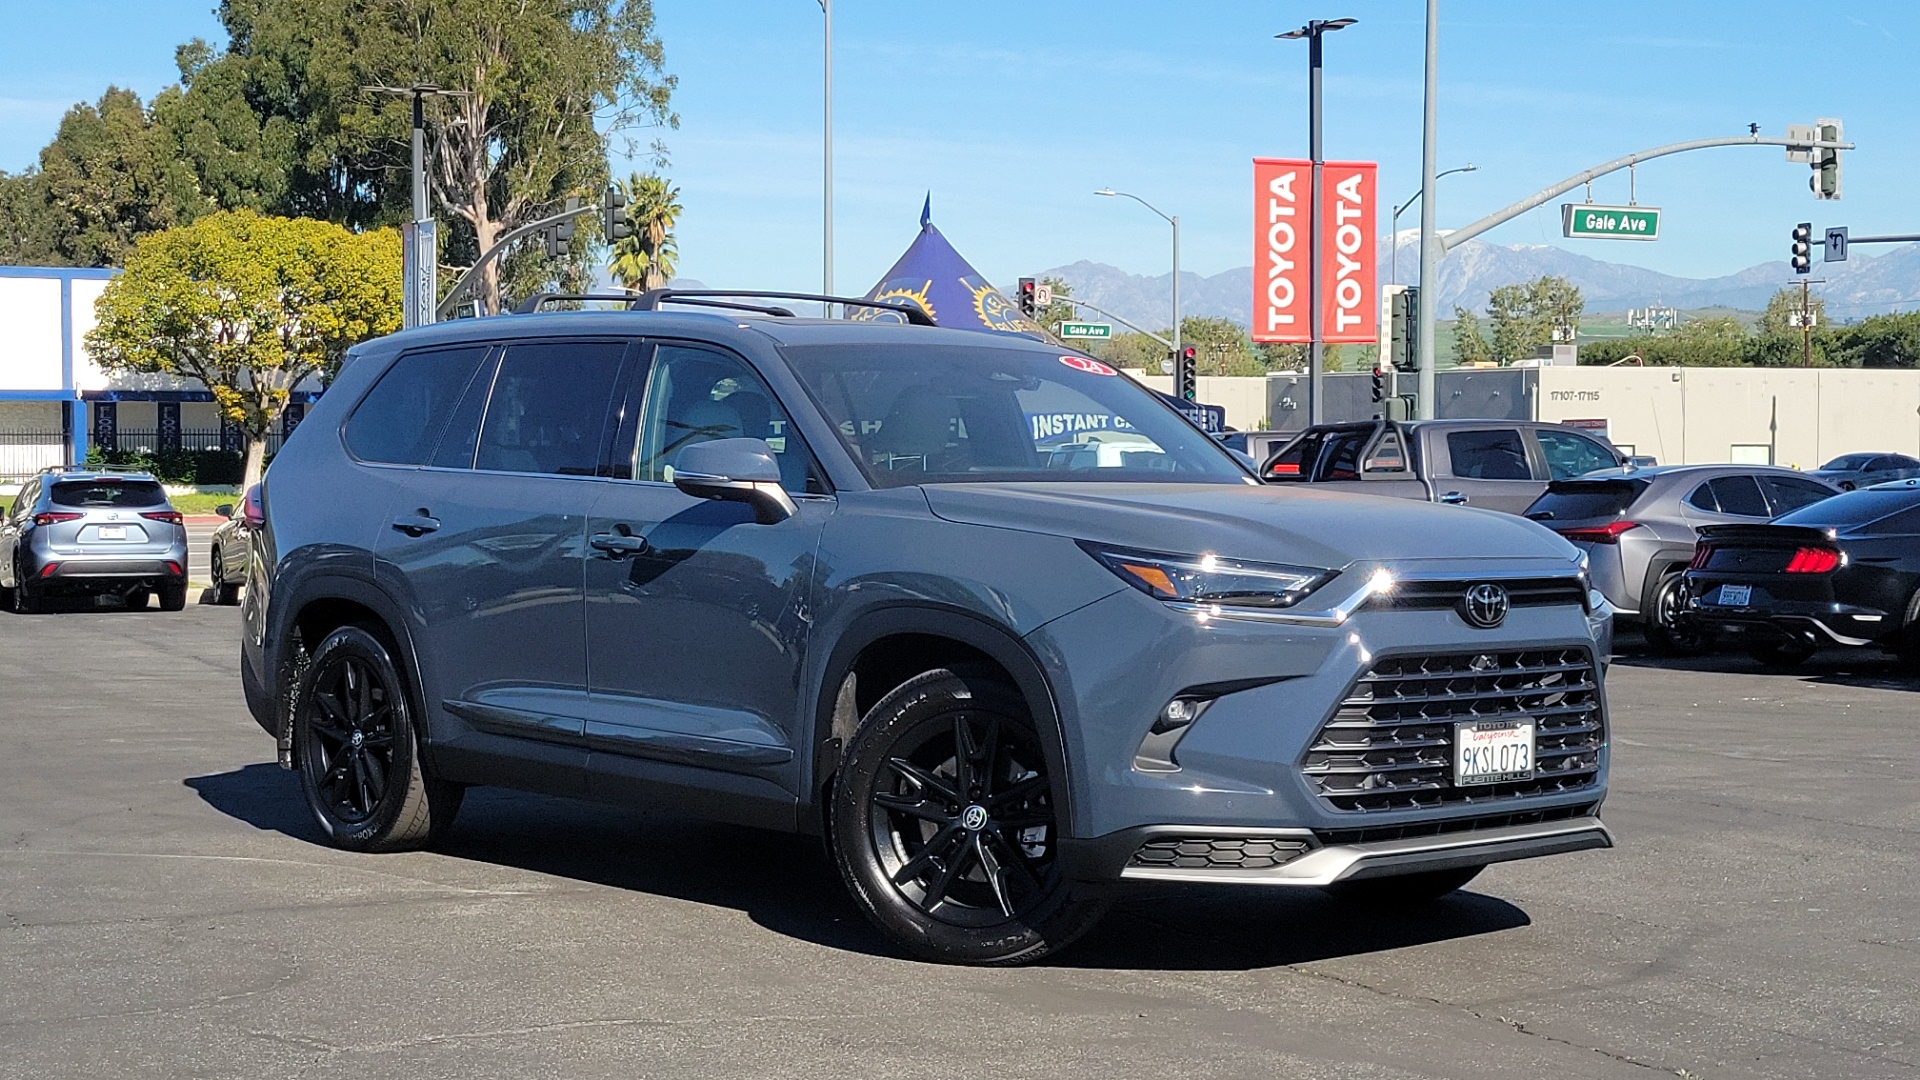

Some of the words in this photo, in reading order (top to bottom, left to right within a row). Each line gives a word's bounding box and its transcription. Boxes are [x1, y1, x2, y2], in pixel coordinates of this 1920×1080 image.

[1585, 213, 1616, 230] Gale
[1618, 214, 1647, 231] Ave
[1268, 171, 1296, 332] TOYOTA
[1336, 173, 1362, 333] TOYOTA
[1070, 326, 1087, 334] Gale
[1088, 326, 1105, 335] Ave
[1550, 391, 1600, 401] 17107-17115
[1032, 414, 1109, 440] INSTANT
[1463, 744, 1528, 775] 9KSL073
[1503, 772, 1530, 780] HILLS
